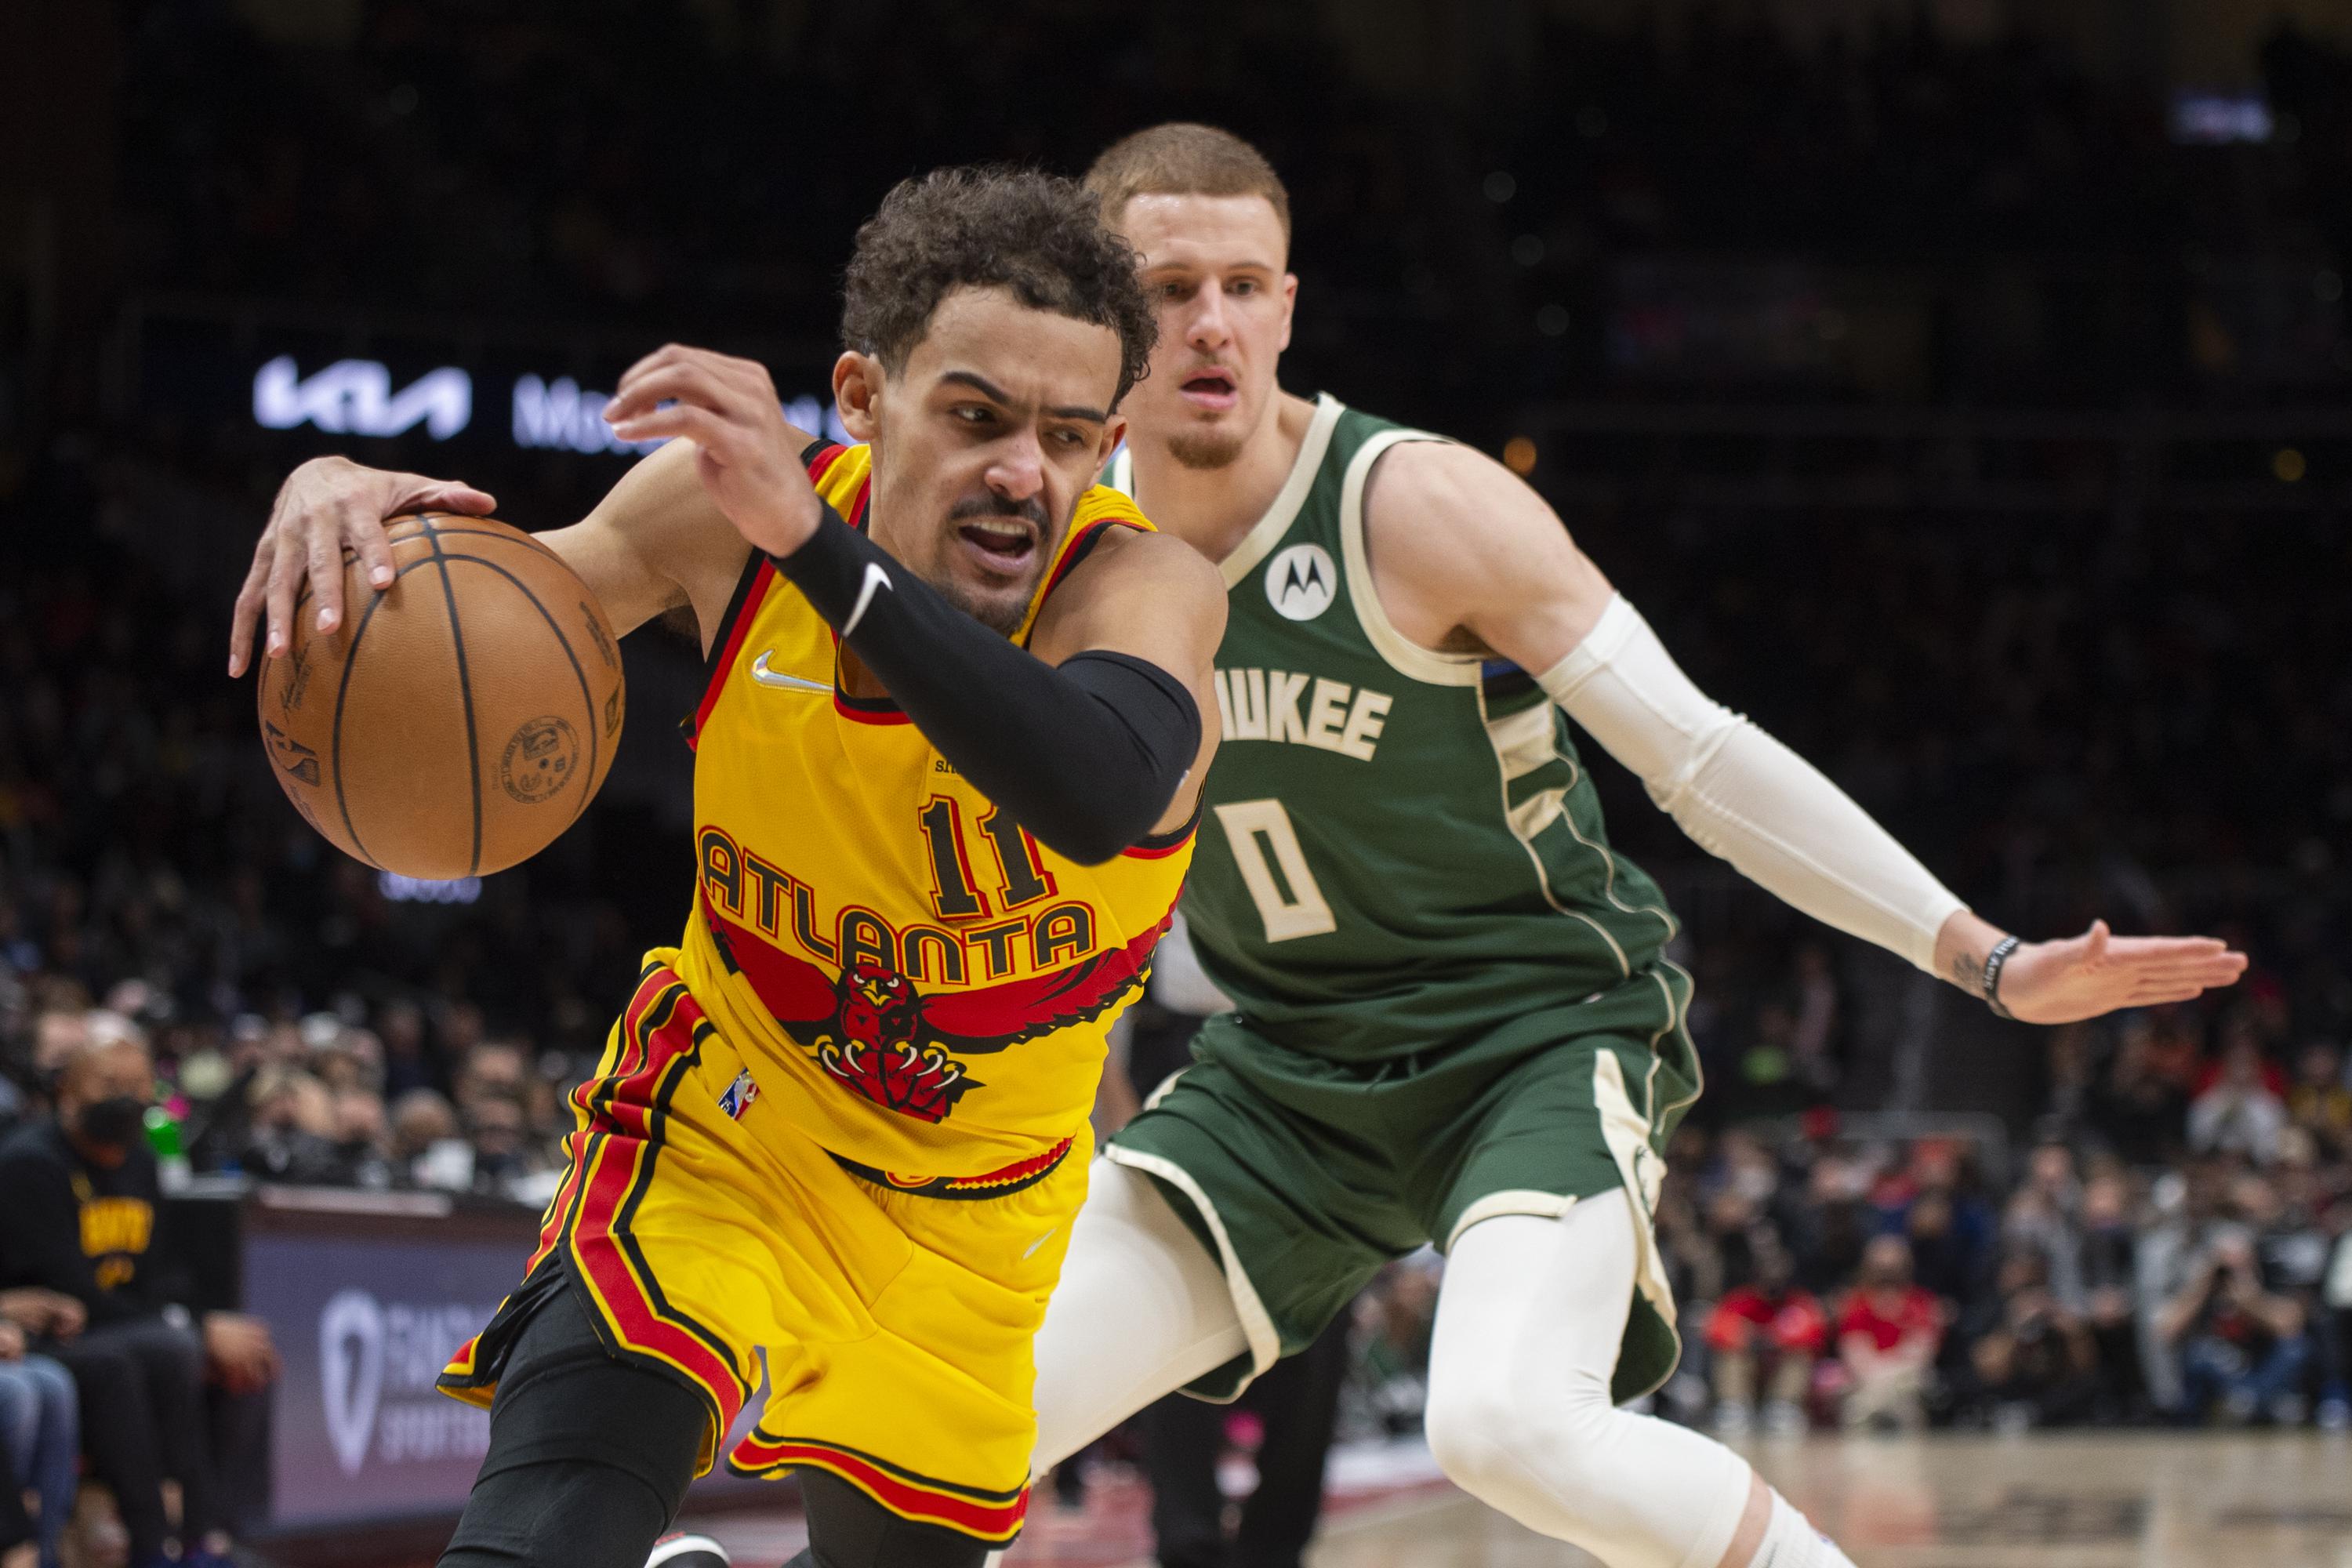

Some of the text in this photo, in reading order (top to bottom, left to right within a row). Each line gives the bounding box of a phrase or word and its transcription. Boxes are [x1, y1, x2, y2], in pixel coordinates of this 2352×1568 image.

[699, 825, 1096, 985] ATLANTA
[918, 793, 1059, 921] 11
[1213, 797, 1337, 943] 0
